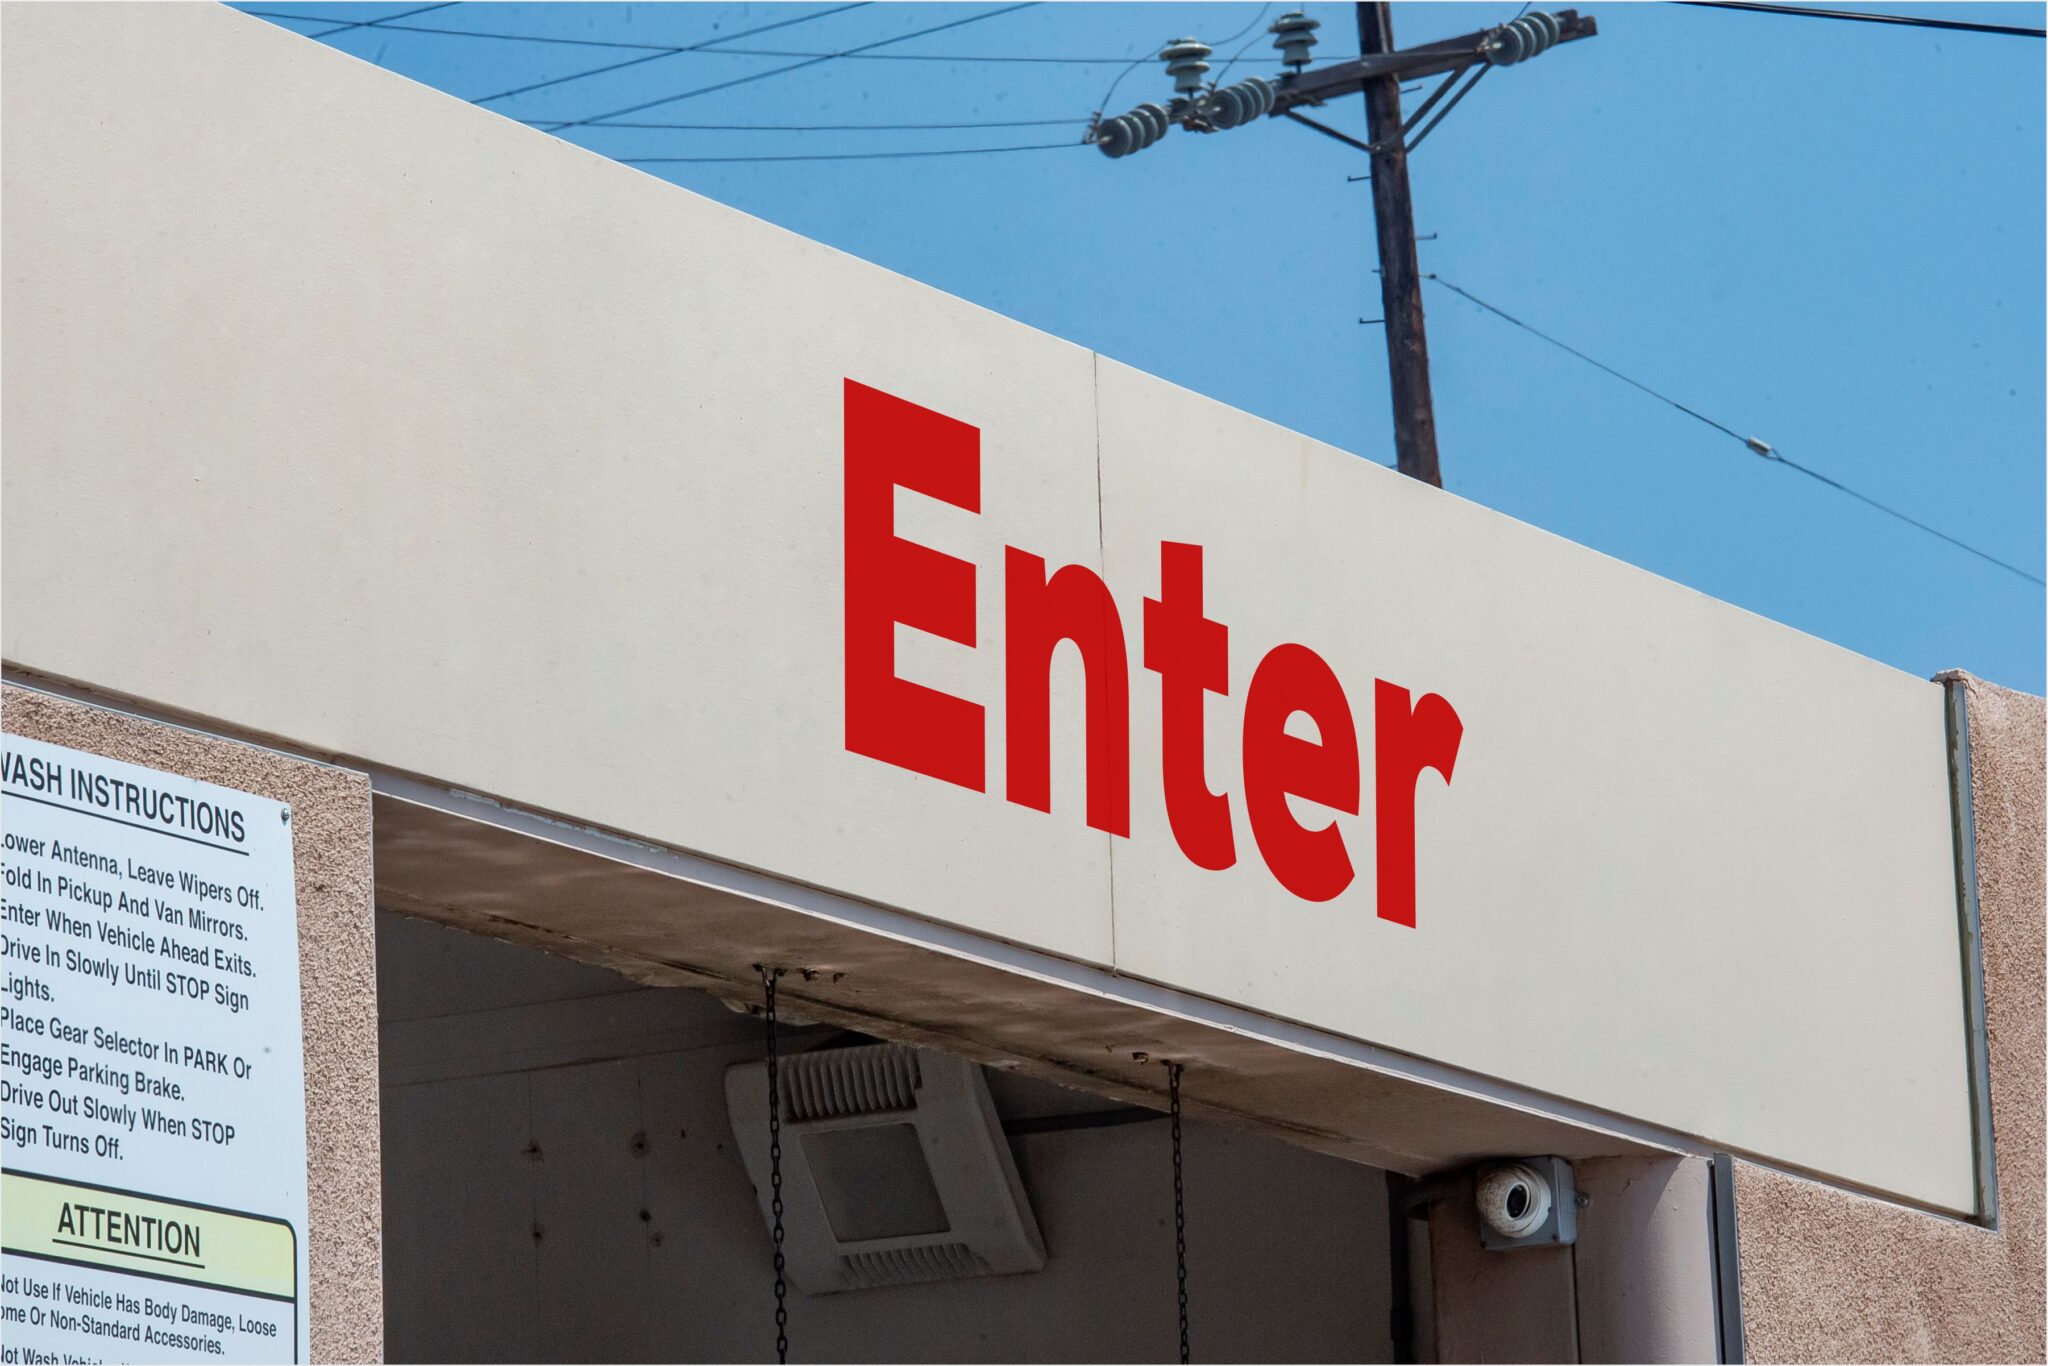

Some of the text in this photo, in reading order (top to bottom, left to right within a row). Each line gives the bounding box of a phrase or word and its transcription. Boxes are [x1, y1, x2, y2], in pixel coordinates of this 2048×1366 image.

[844, 378, 1464, 930] Enter
[70, 768, 245, 843] INSTRUCTIONS
[1, 833, 264, 911] ower Antenna, Leave Wipers Off.
[37, 870, 52, 895] In
[57, 875, 113, 913] Pickup
[117, 891, 150, 918] And
[154, 899, 184, 926] Van
[188, 907, 248, 941] Mirrors.
[1, 934, 249, 1014] Drive In Slowly Until STOP Sign
[45, 908, 92, 940] When
[97, 920, 155, 954] Vehicle
[159, 936, 209, 967] Ahead
[214, 948, 256, 978] Exits.
[1, 1006, 252, 1080] Place Gear Selector In PARK Or
[1, 1042, 185, 1101] Engage Parking Brake.
[1, 1079, 235, 1146] Drive Out Slowly When STOP
[1, 1116, 124, 1161] Sign Turns Off.
[57, 1201, 200, 1258] ATTENTION
[23, 1277, 49, 1300] Use
[52, 1282, 61, 1302] If
[64, 1284, 113, 1310] Vehicle
[116, 1292, 141, 1315] Has
[144, 1297, 178, 1325] Body
[181, 1304, 235, 1334] Damage,
[239, 1313, 277, 1338] Loose
[29, 1305, 47, 1327] Or
[50, 1309, 140, 1342] Non-Standard
[144, 1324, 225, 1355] Accessories.
